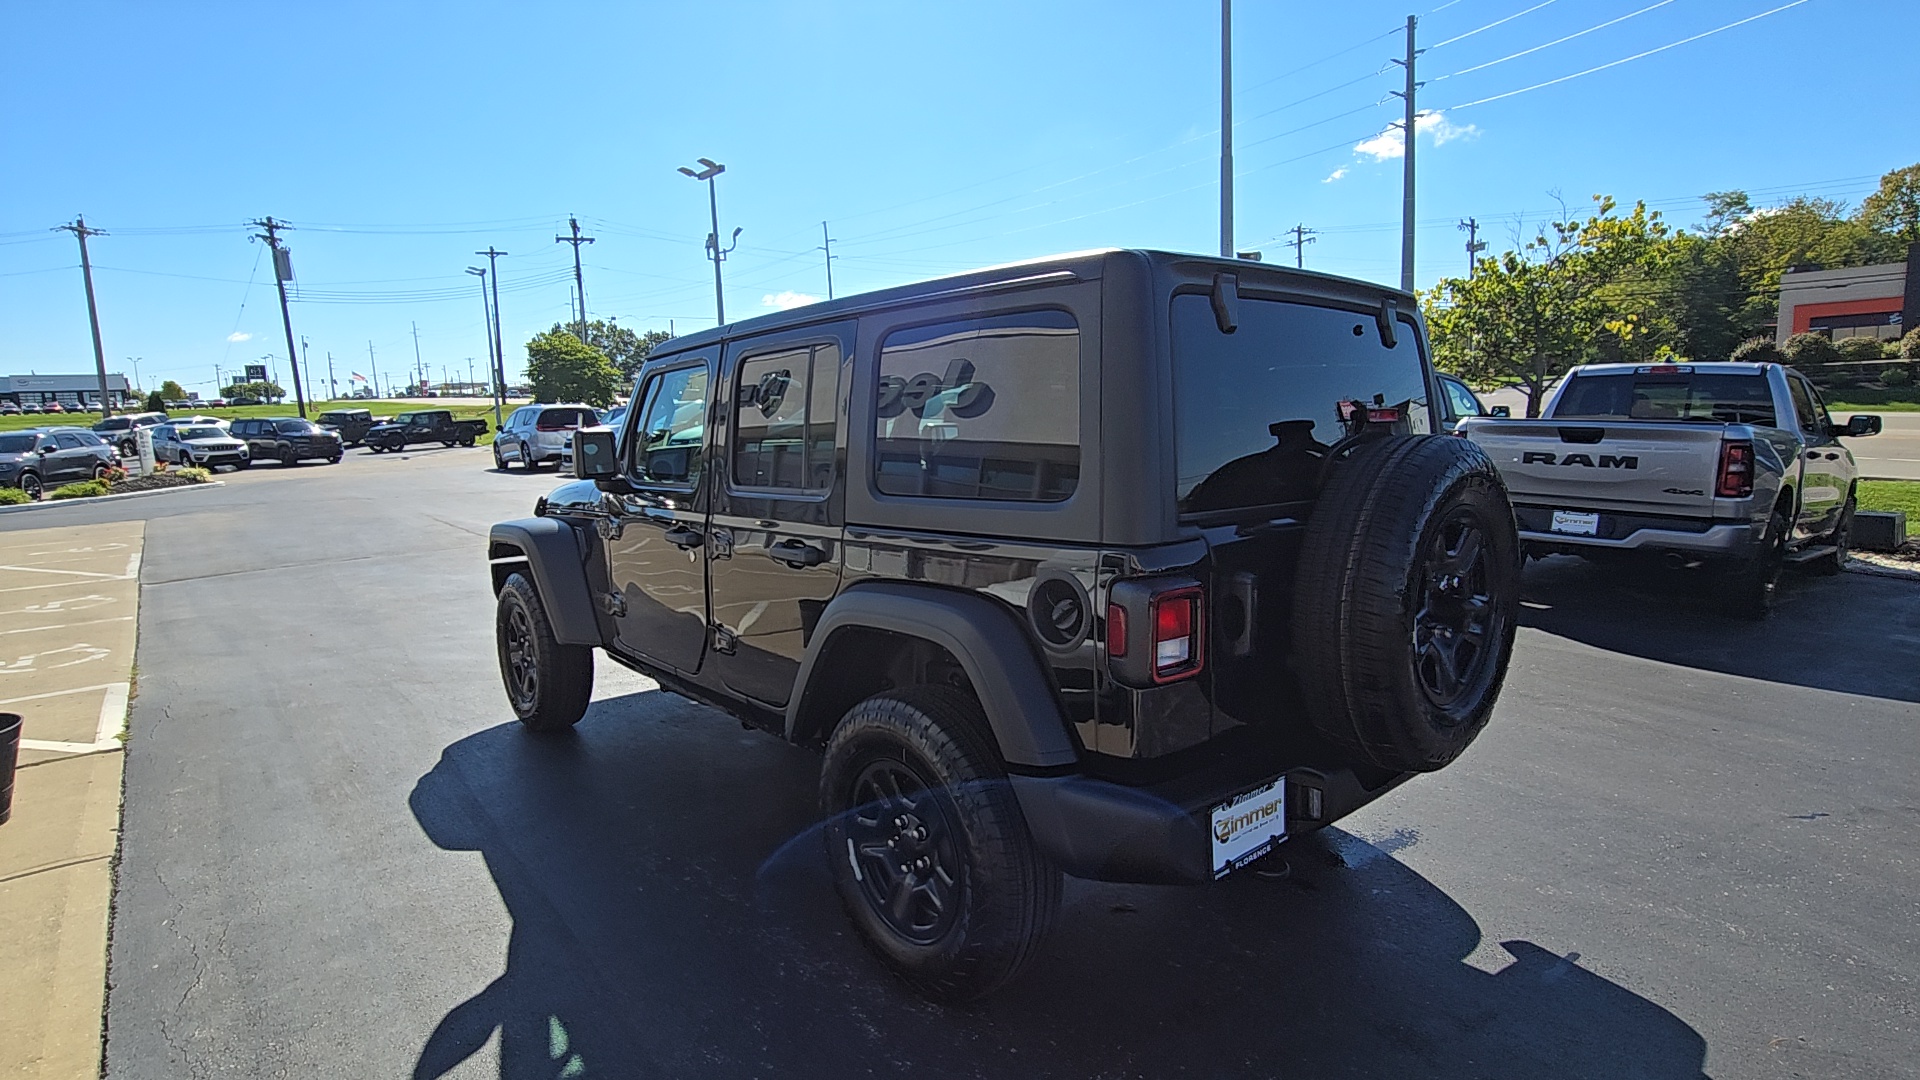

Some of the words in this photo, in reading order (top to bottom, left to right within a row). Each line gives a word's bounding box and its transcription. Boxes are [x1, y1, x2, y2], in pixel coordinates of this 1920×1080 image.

[1522, 451, 1638, 470] RAM
[1662, 488, 1704, 497] 4x4
[1232, 784, 1269, 807] Zimmer
[1215, 798, 1282, 842] Zimmer
[1235, 844, 1272, 870] FLORENCE
